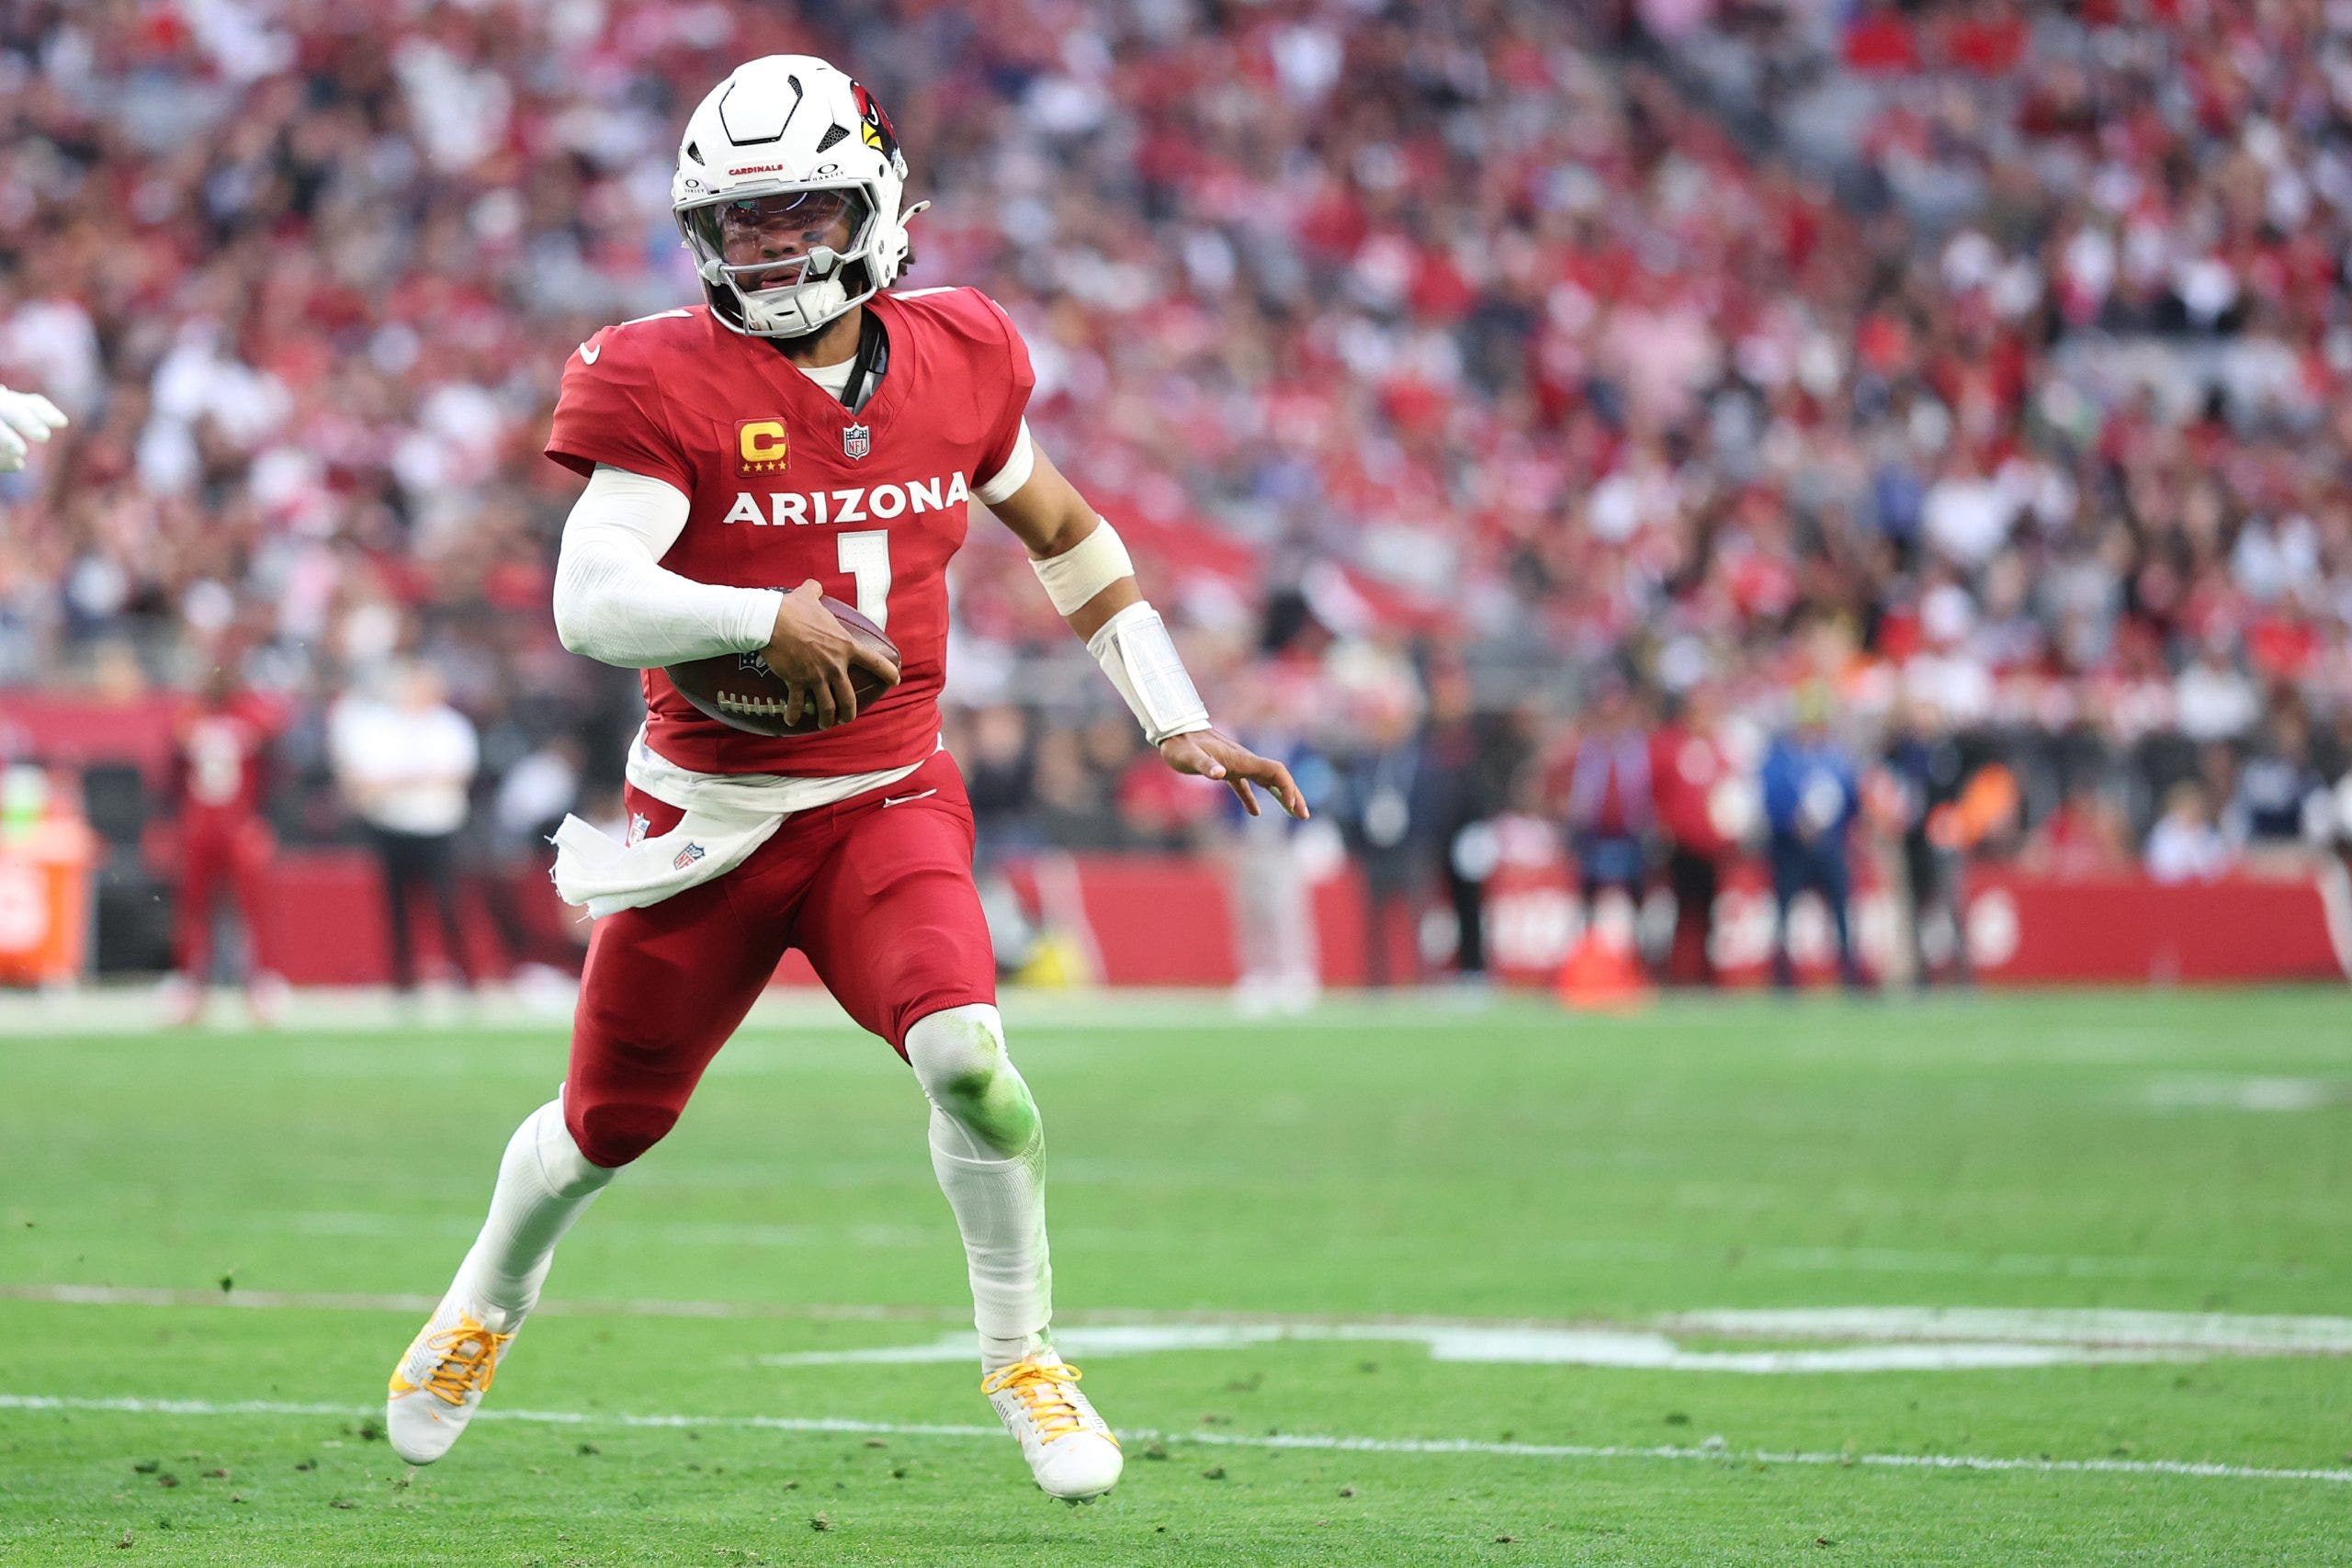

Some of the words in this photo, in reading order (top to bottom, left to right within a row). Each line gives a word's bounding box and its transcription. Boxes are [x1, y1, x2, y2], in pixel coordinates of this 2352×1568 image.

[729, 164, 784, 175] CARDINALS
[740, 422, 786, 462] C
[848, 440, 866, 454] NFL
[722, 470, 970, 526] ARIZONA
[837, 529, 891, 634] 1
